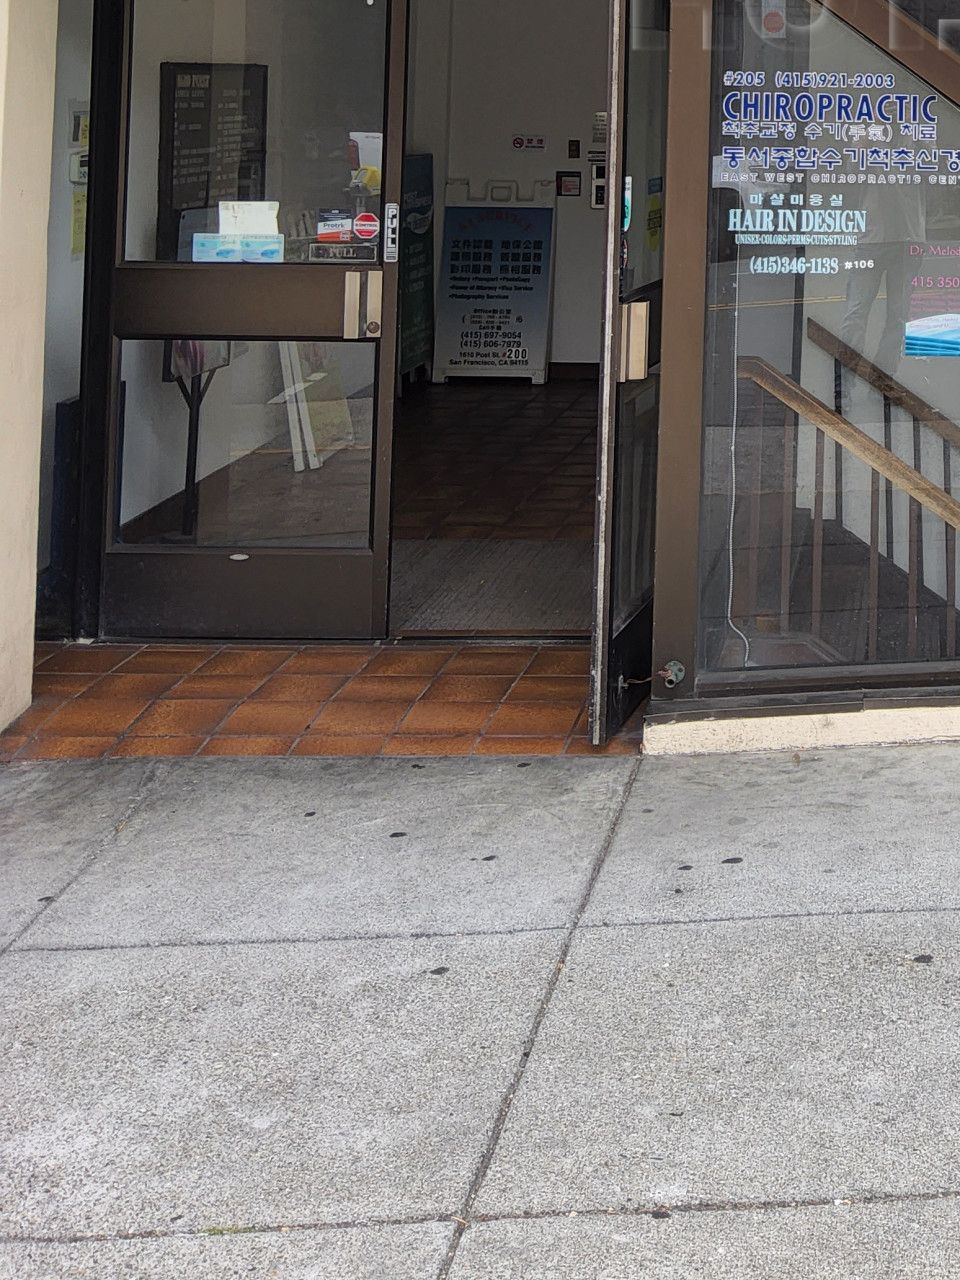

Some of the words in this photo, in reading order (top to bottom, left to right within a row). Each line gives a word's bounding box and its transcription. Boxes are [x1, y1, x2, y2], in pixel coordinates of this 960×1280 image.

[724, 71, 766, 87] #205
[775, 71, 896, 88] (415)921-2003
[723, 92, 939, 123] CHIROPRACTIC
[722, 122, 797, 141] 척추교정
[900, 122, 937, 141] 치료
[720, 173, 758, 183] EAST
[764, 173, 804, 183] WEST
[811, 173, 922, 185] CHIROPRACTIC
[387, 208, 398, 248] PULL
[728, 209, 775, 232] HAIR
[778, 209, 798, 232] IN
[801, 209, 867, 233] DESIGN
[909, 245, 926, 256] Dr.
[844, 259, 874, 269] #106
[461, 331, 482, 340] (415)
[484, 331, 522, 339] 697-9054
[460, 340, 481, 349] (415)
